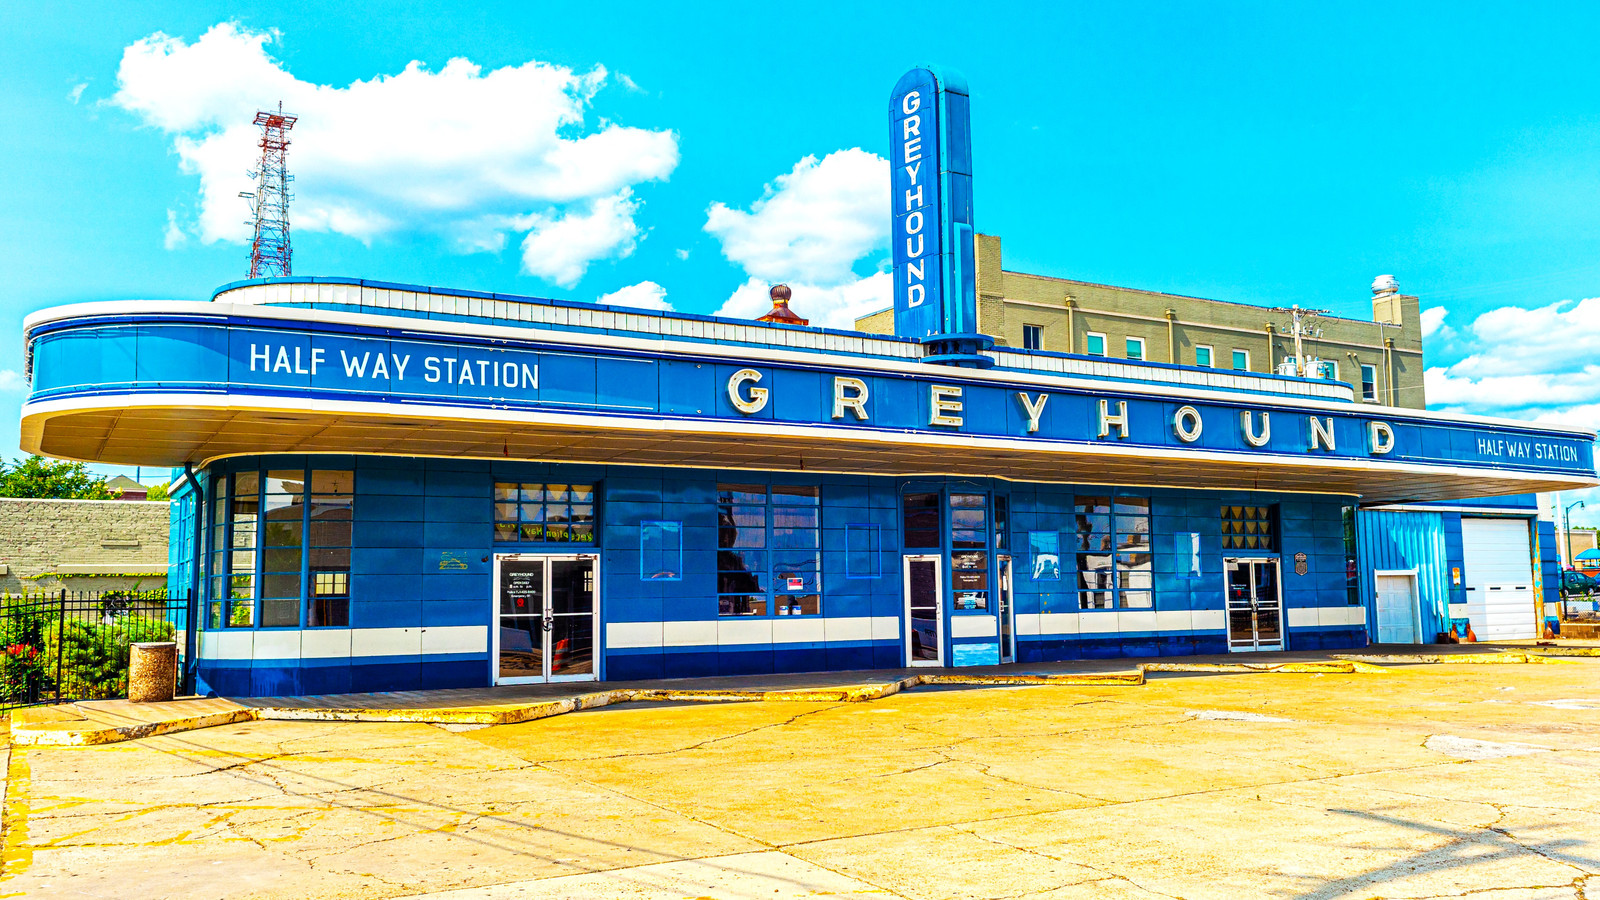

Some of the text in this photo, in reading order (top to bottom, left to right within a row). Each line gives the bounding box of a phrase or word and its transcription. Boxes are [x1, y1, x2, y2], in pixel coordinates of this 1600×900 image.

[902, 90, 926, 308] GREYHOUND
[250, 343, 539, 389] HALF WAY STATION
[727, 368, 1395, 456] GREYHOUND
[1478, 438, 1578, 462] HALF WAY STATION
